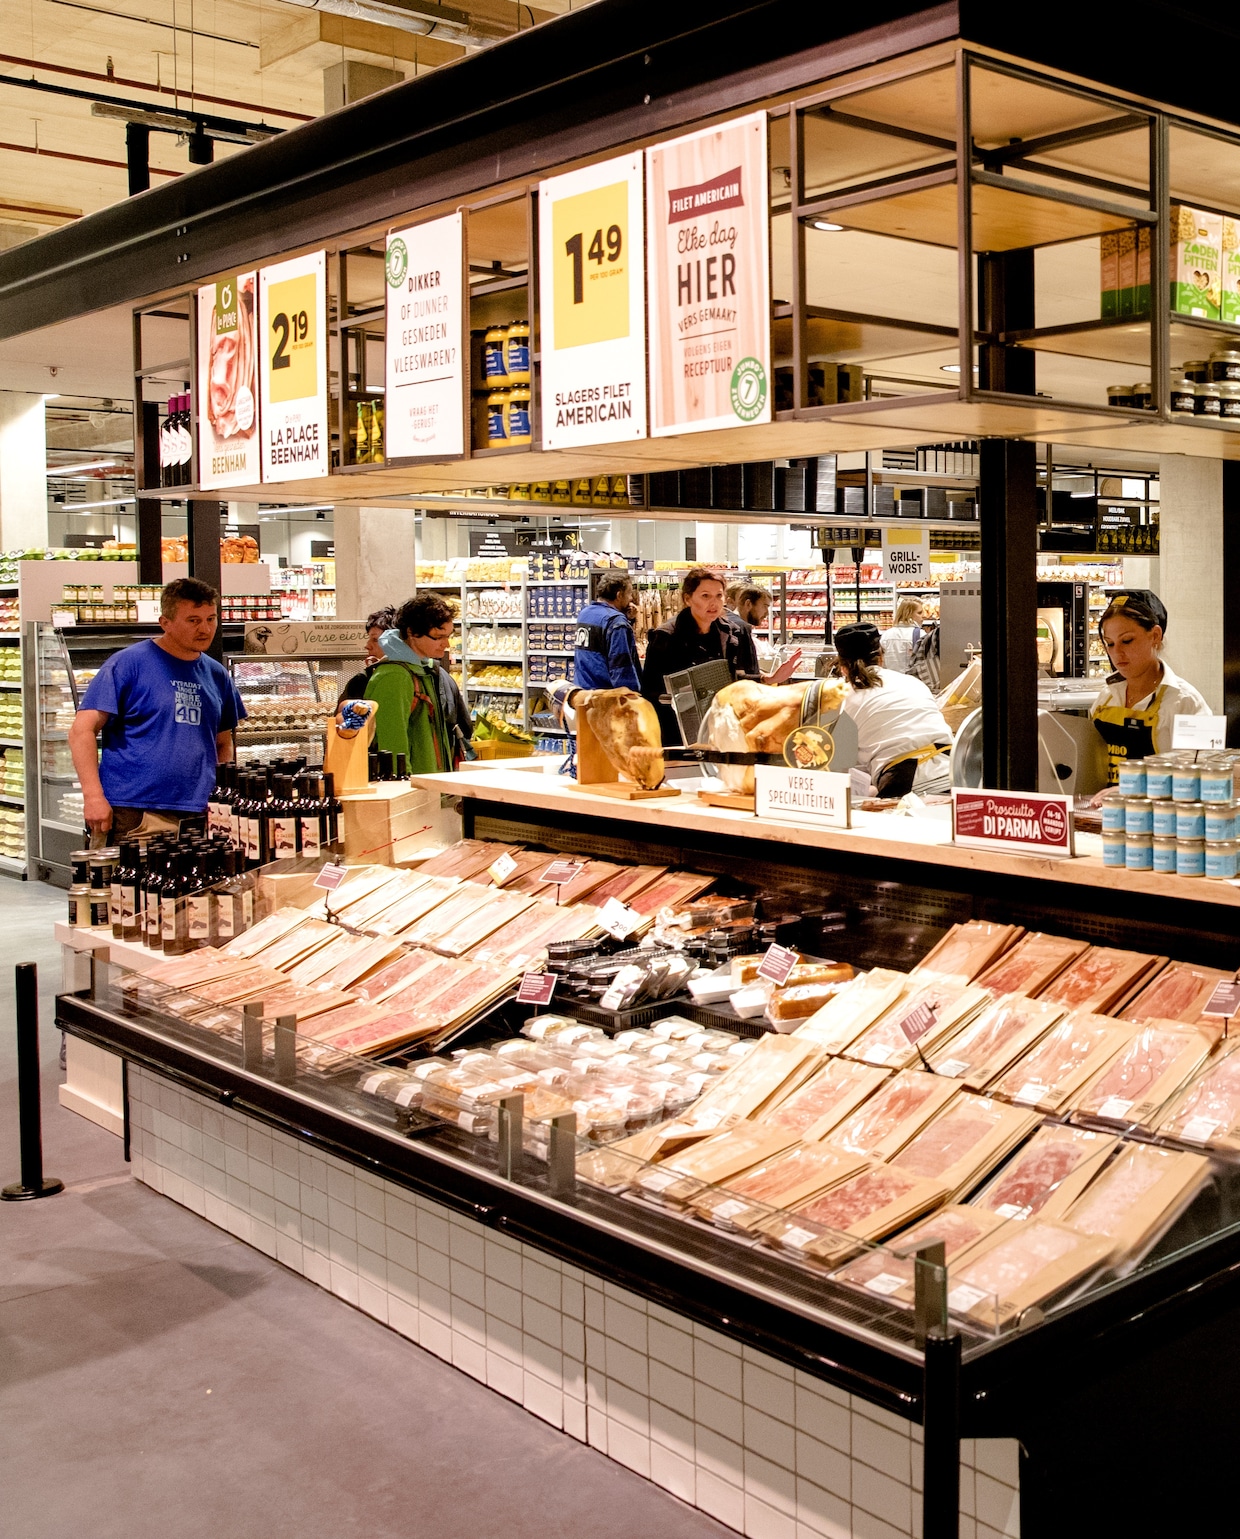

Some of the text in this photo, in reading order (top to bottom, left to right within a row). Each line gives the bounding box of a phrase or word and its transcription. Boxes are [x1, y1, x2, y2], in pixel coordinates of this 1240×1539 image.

[672, 183, 739, 213] FILET AMERICAIN
[677, 220, 738, 254] Elke dag
[394, 254, 400, 271] 7
[1184, 254, 1218, 271] PITTEN
[408, 271, 441, 293] DIKKER
[589, 268, 624, 281] PER 100 GRAM
[677, 253, 737, 307] HIER
[401, 295, 449, 321] OF DUNNER
[678, 307, 737, 333] VERS GEMAAKT
[402, 322, 447, 346] GESNEDEN
[684, 339, 732, 358] VOLGENS EIGEN
[394, 348, 456, 374] VLEESWAREN?
[684, 356, 732, 379] RECEPTUUR
[736, 358, 765, 382] JUMBO'S
[555, 382, 631, 406] SLAGERS FILET
[745, 378, 753, 400] 7
[556, 400, 632, 428] AMERICAIN
[270, 423, 318, 447] LA PLACE
[212, 453, 247, 475] BEENHAM
[271, 443, 320, 466] BEENHAM
[890, 551, 920, 562] GRILL-
[888, 563, 923, 574] WORST
[300, 630, 370, 644] Verse eiere
[177, 706, 199, 723] 40
[1107, 743, 1128, 756] MBO
[788, 775, 814, 791] VERSE
[768, 789, 835, 810] SPECIALITEITEN
[986, 799, 1036, 818] Prosciutto
[983, 815, 1042, 840] DI PARMA
[1043, 817, 1064, 829] MAANDEN
